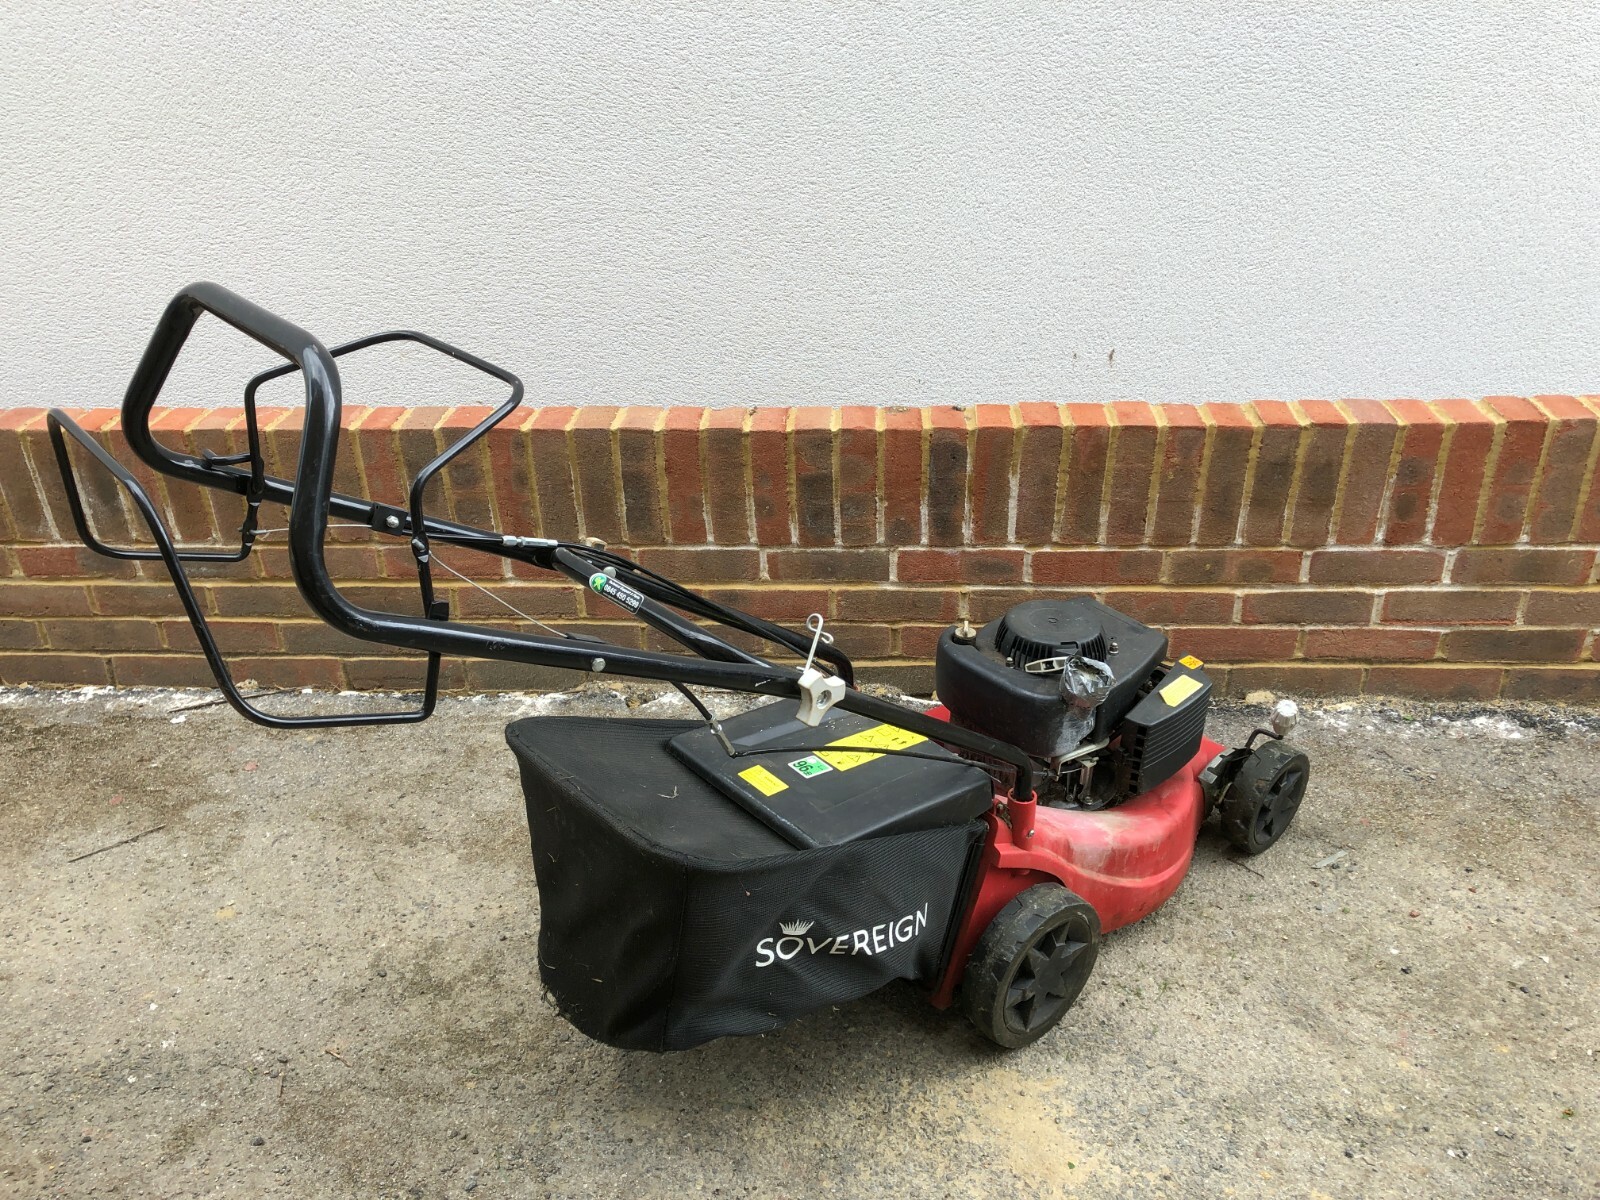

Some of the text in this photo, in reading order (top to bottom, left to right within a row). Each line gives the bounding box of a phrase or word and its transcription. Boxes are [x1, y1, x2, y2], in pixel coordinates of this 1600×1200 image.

[604, 584, 617, 595] 0845
[793, 760, 813, 772] 96
[755, 902, 928, 967] SOVEREIGN
